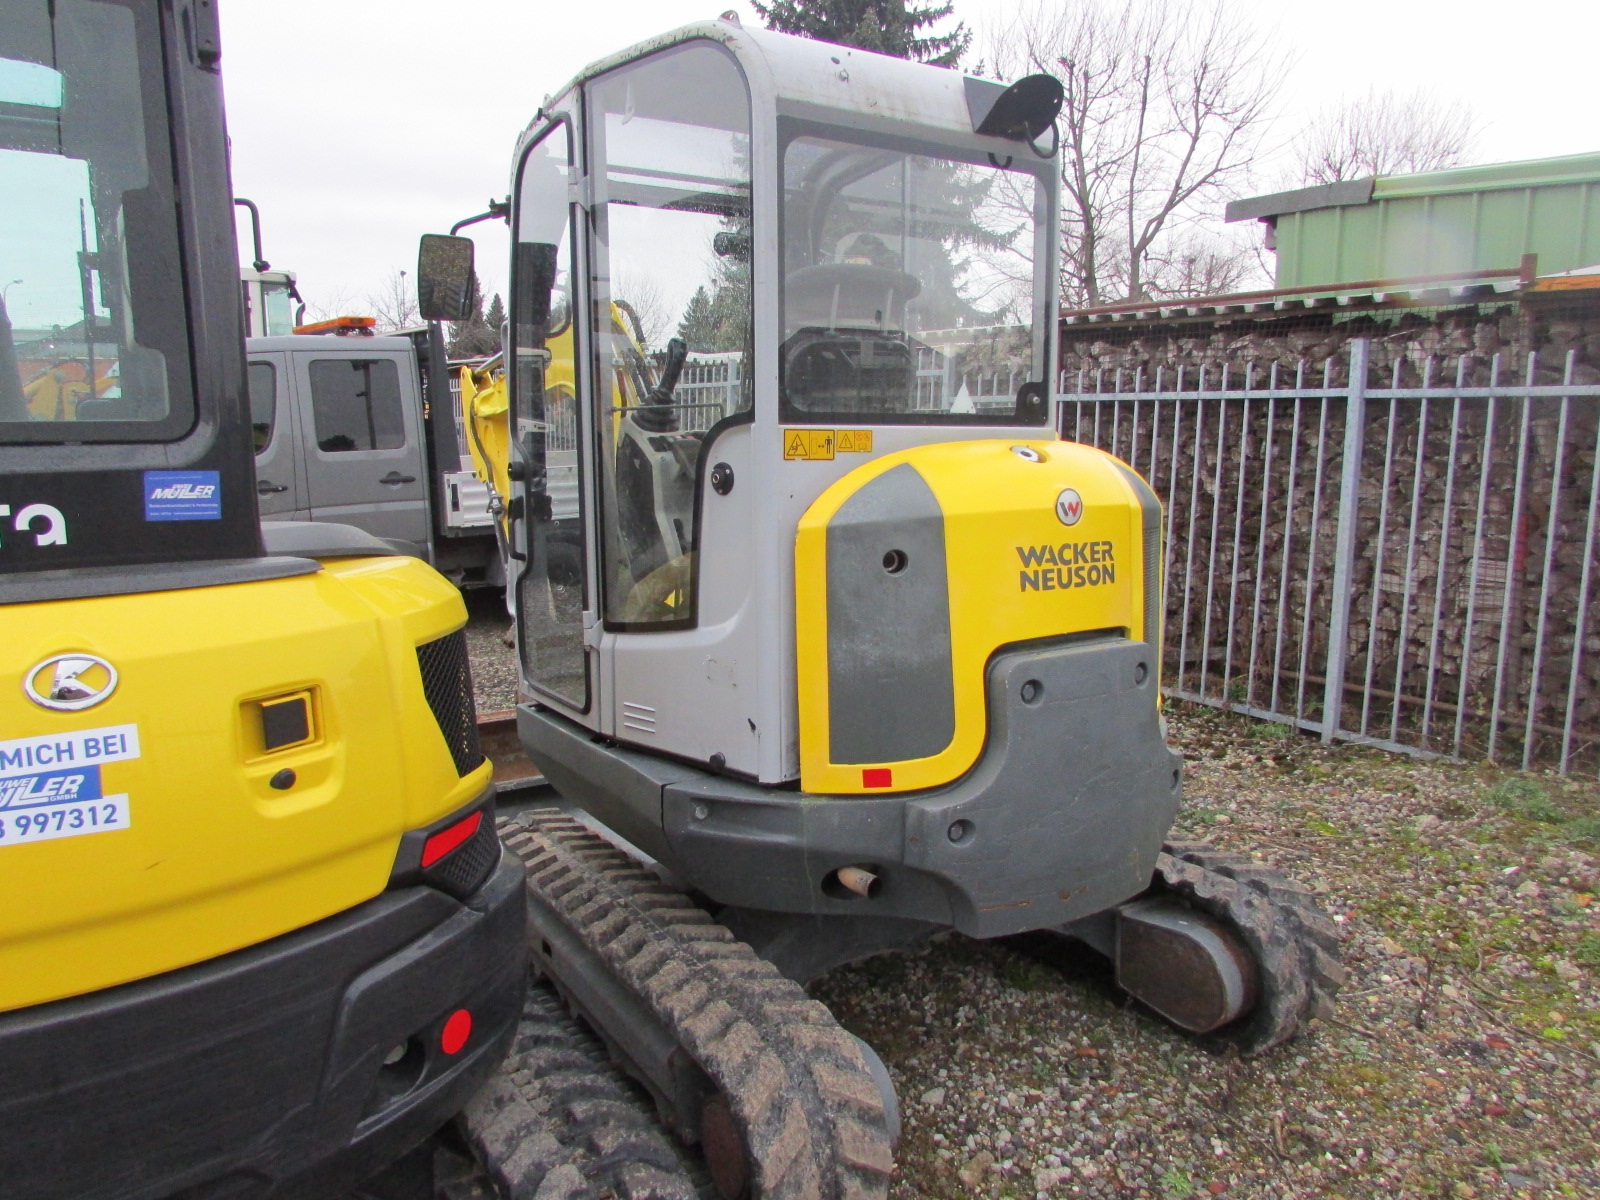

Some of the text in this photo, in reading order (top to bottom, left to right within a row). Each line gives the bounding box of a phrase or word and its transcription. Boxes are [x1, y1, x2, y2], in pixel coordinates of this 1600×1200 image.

[1016, 541, 1114, 568] WACKER
[1020, 563, 1115, 592] NEUSON
[0, 734, 127, 770] MICH BEI
[50, 793, 77, 801] GMBH
[15, 804, 117, 836] 997312
